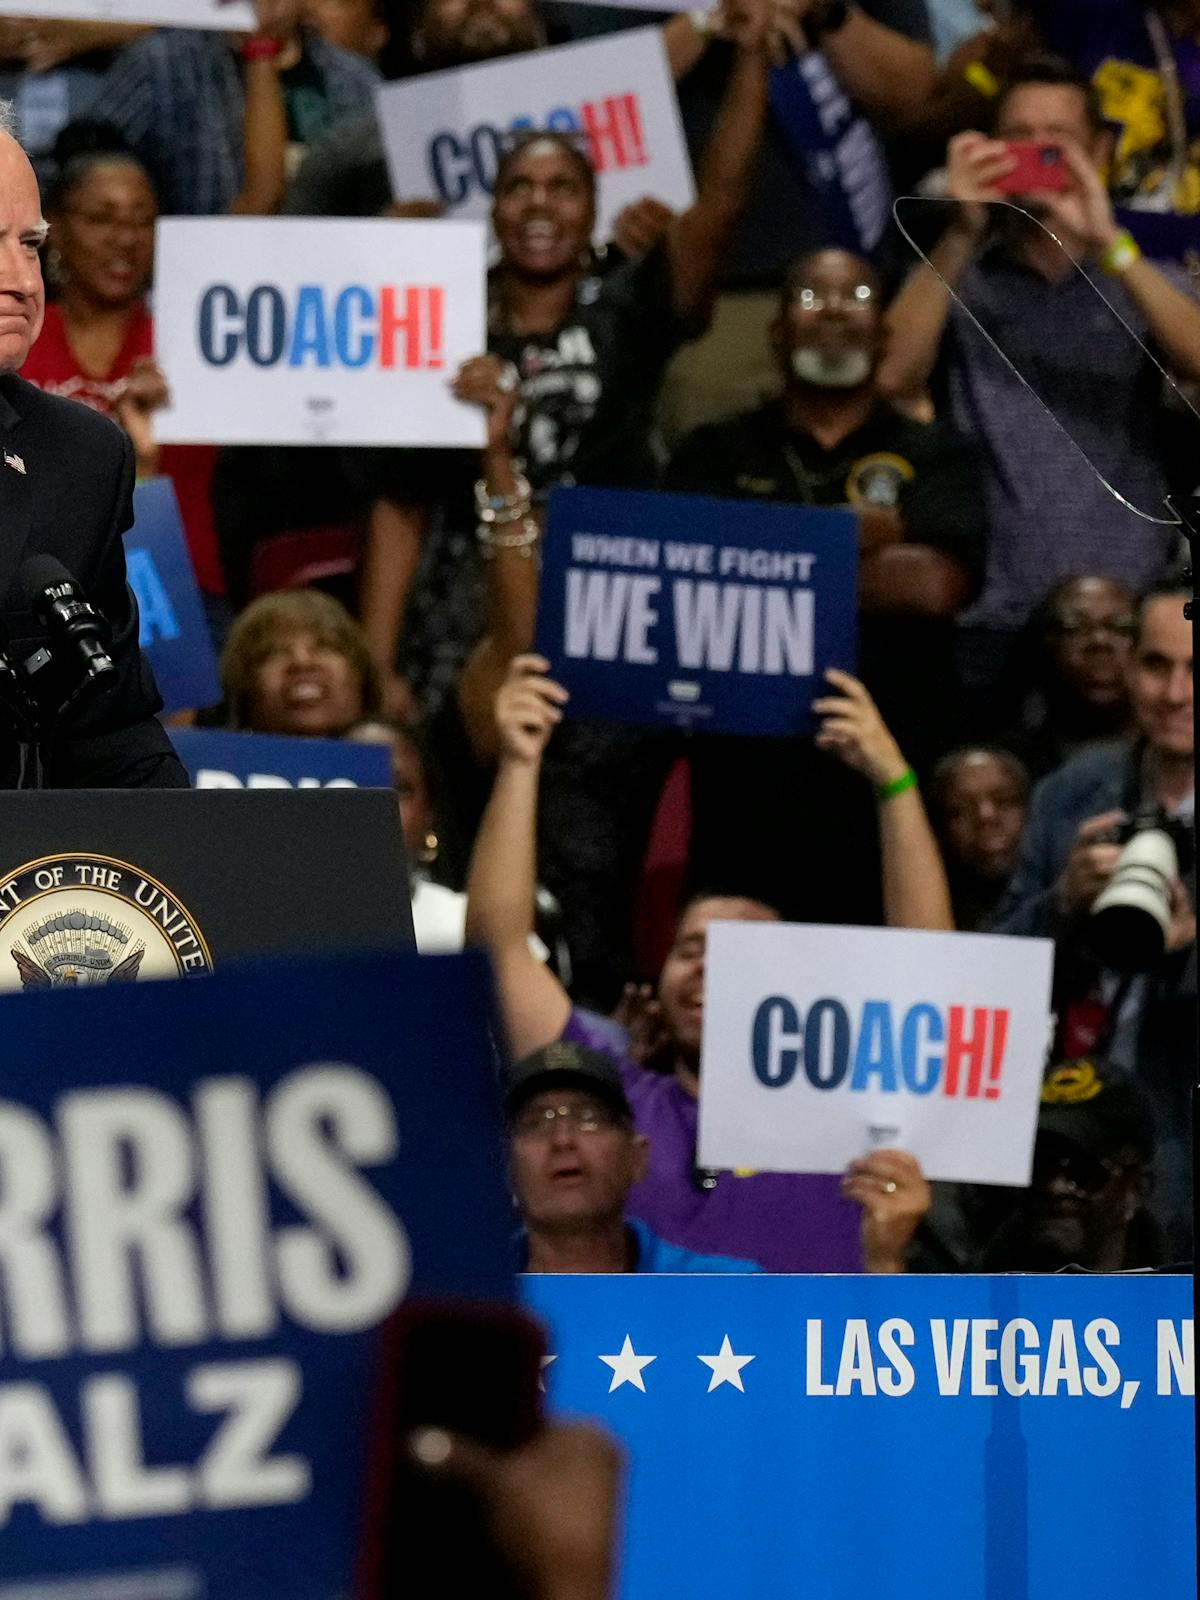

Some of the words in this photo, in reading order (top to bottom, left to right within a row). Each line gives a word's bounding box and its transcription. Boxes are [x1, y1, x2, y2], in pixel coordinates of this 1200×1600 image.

[430, 92, 649, 203] COH!
[198, 285, 445, 369] COACH!
[571, 533, 660, 568] WHEN
[664, 541, 714, 573] WE
[720, 547, 816, 581] FIGHT
[565, 567, 661, 665] WE
[673, 578, 816, 676] WIN
[34, 866, 64, 890] OF
[75, 865, 122, 891] THE
[134, 880, 205, 972] UNITE
[752, 996, 1010, 1101] COACH!
[806, 1317, 916, 1397] LAS
[930, 1317, 1141, 1409] VEGAS,
[1156, 1318, 1195, 1396] N
